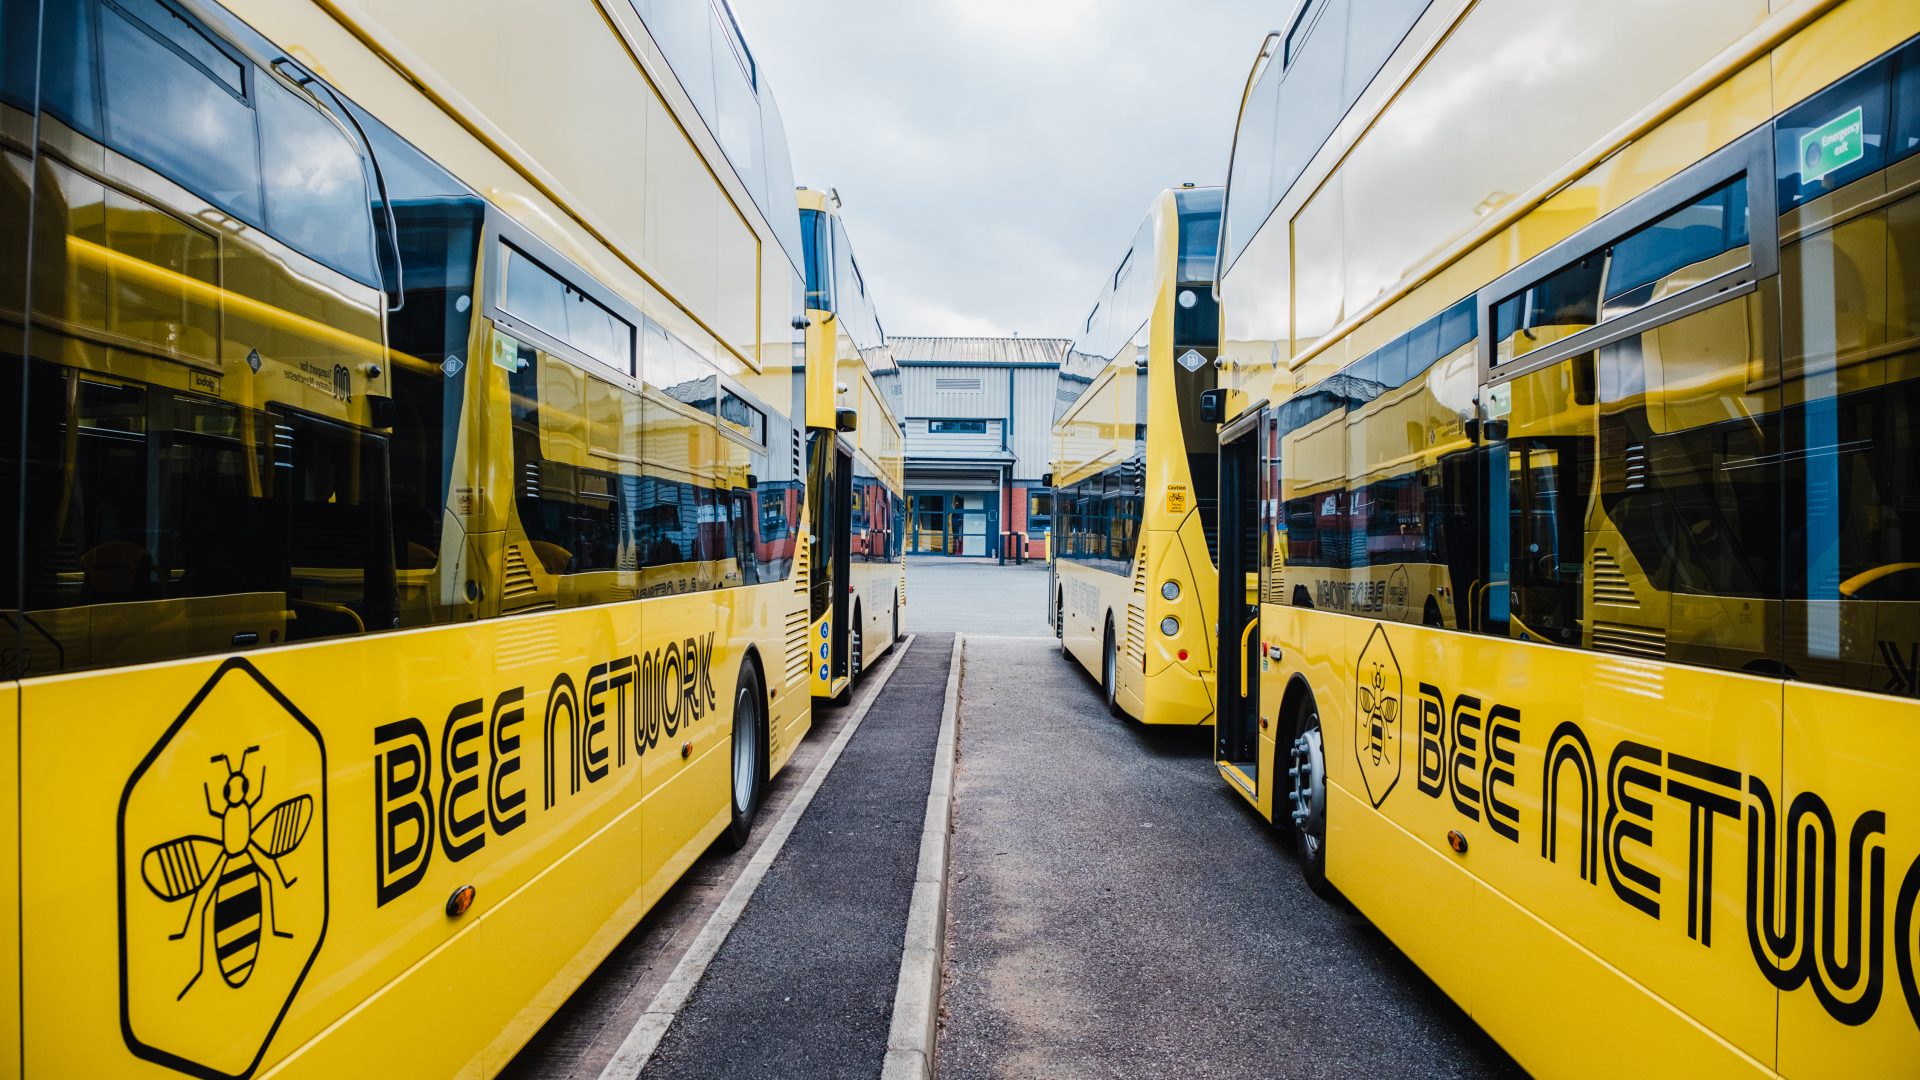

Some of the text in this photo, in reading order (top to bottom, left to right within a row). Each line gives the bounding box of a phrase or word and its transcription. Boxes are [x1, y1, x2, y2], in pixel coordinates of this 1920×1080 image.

[1821, 121, 1861, 148] Emergency
[1834, 141, 1849, 156] exit
[374, 631, 715, 909] BEE NETWORK
[1418, 682, 1520, 844] BEE
